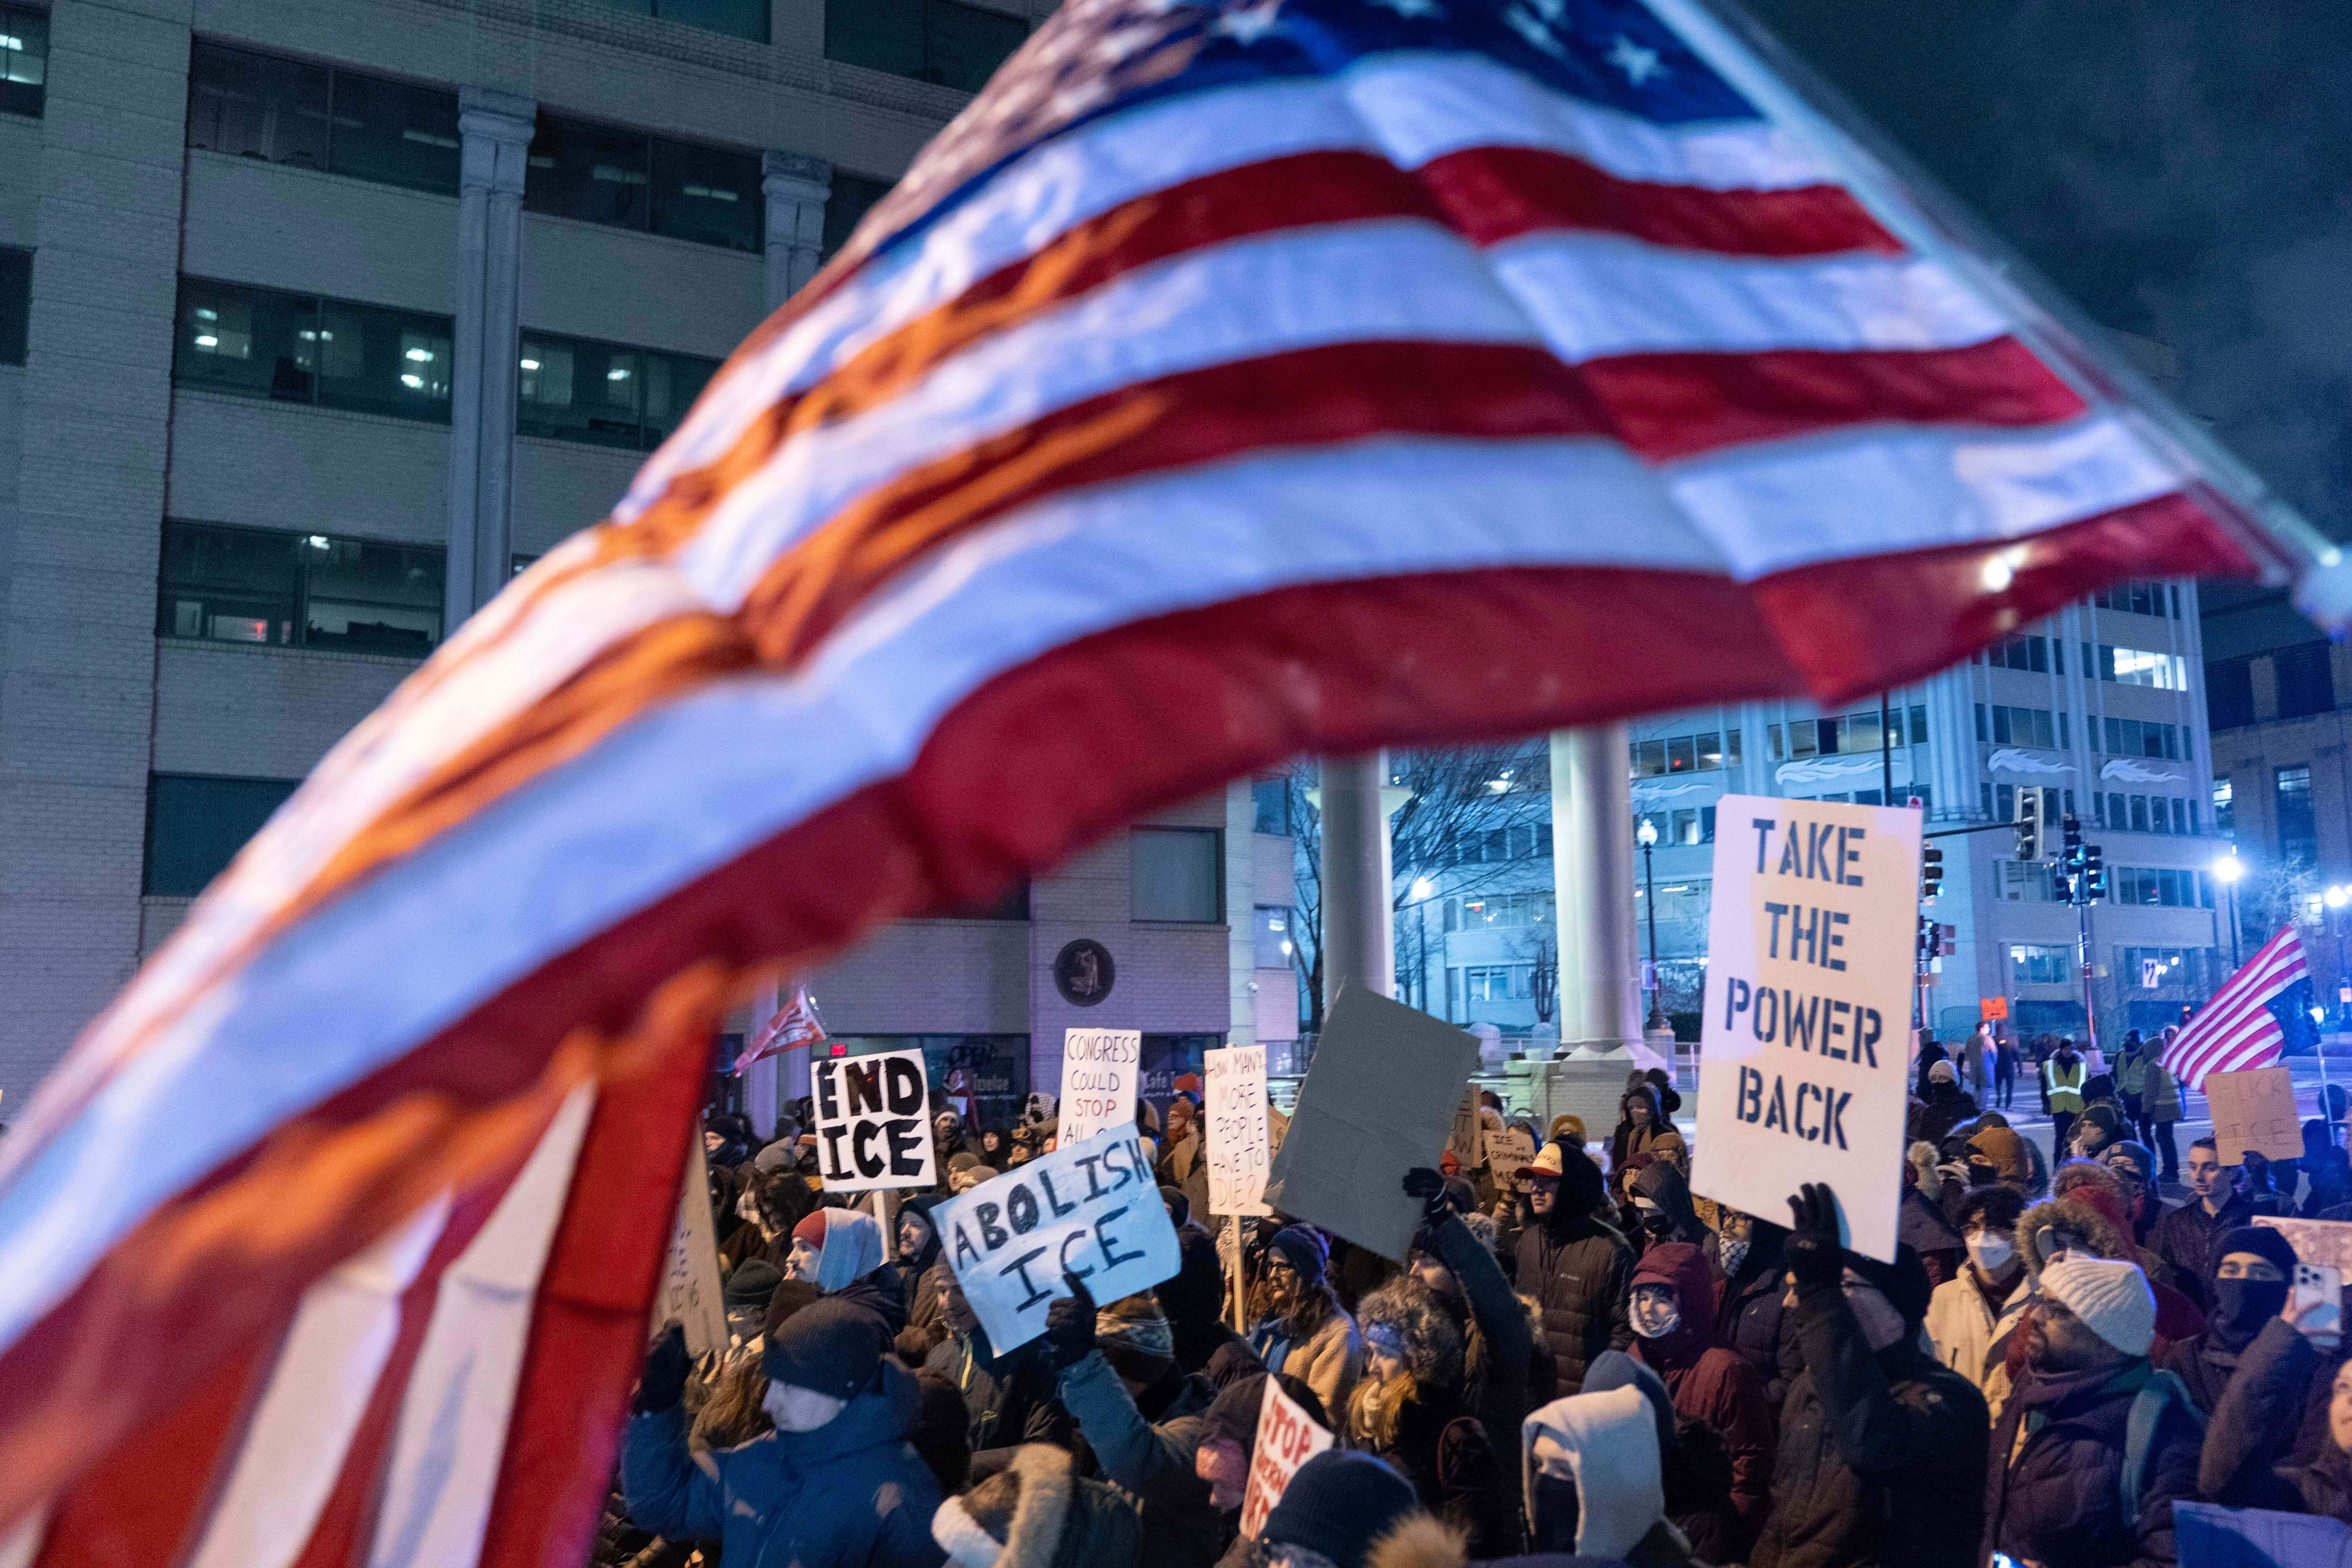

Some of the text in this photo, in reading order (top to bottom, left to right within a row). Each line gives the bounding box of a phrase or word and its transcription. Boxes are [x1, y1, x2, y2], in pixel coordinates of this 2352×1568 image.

[1751, 818, 1865, 887] TAKE
[1764, 901, 1850, 971] THE
[1067, 1034, 1138, 1064] CONGRESS
[1724, 976, 1882, 1069] POWER
[816, 1056, 924, 1120] END
[1070, 1069, 1120, 1092] COULD
[1074, 1098, 1117, 1118] STOP
[1218, 1082, 1257, 1110] MORE
[1736, 1065, 1853, 1151] BACK
[822, 1118, 925, 1181] ICE
[1212, 1145, 1265, 1174] HAVE TO
[1215, 1116, 1264, 1146] PEOPLE
[955, 1137, 1150, 1271] ABOLISH
[1213, 1174, 1257, 1209] DIE?
[999, 1205, 1146, 1314] ICE
